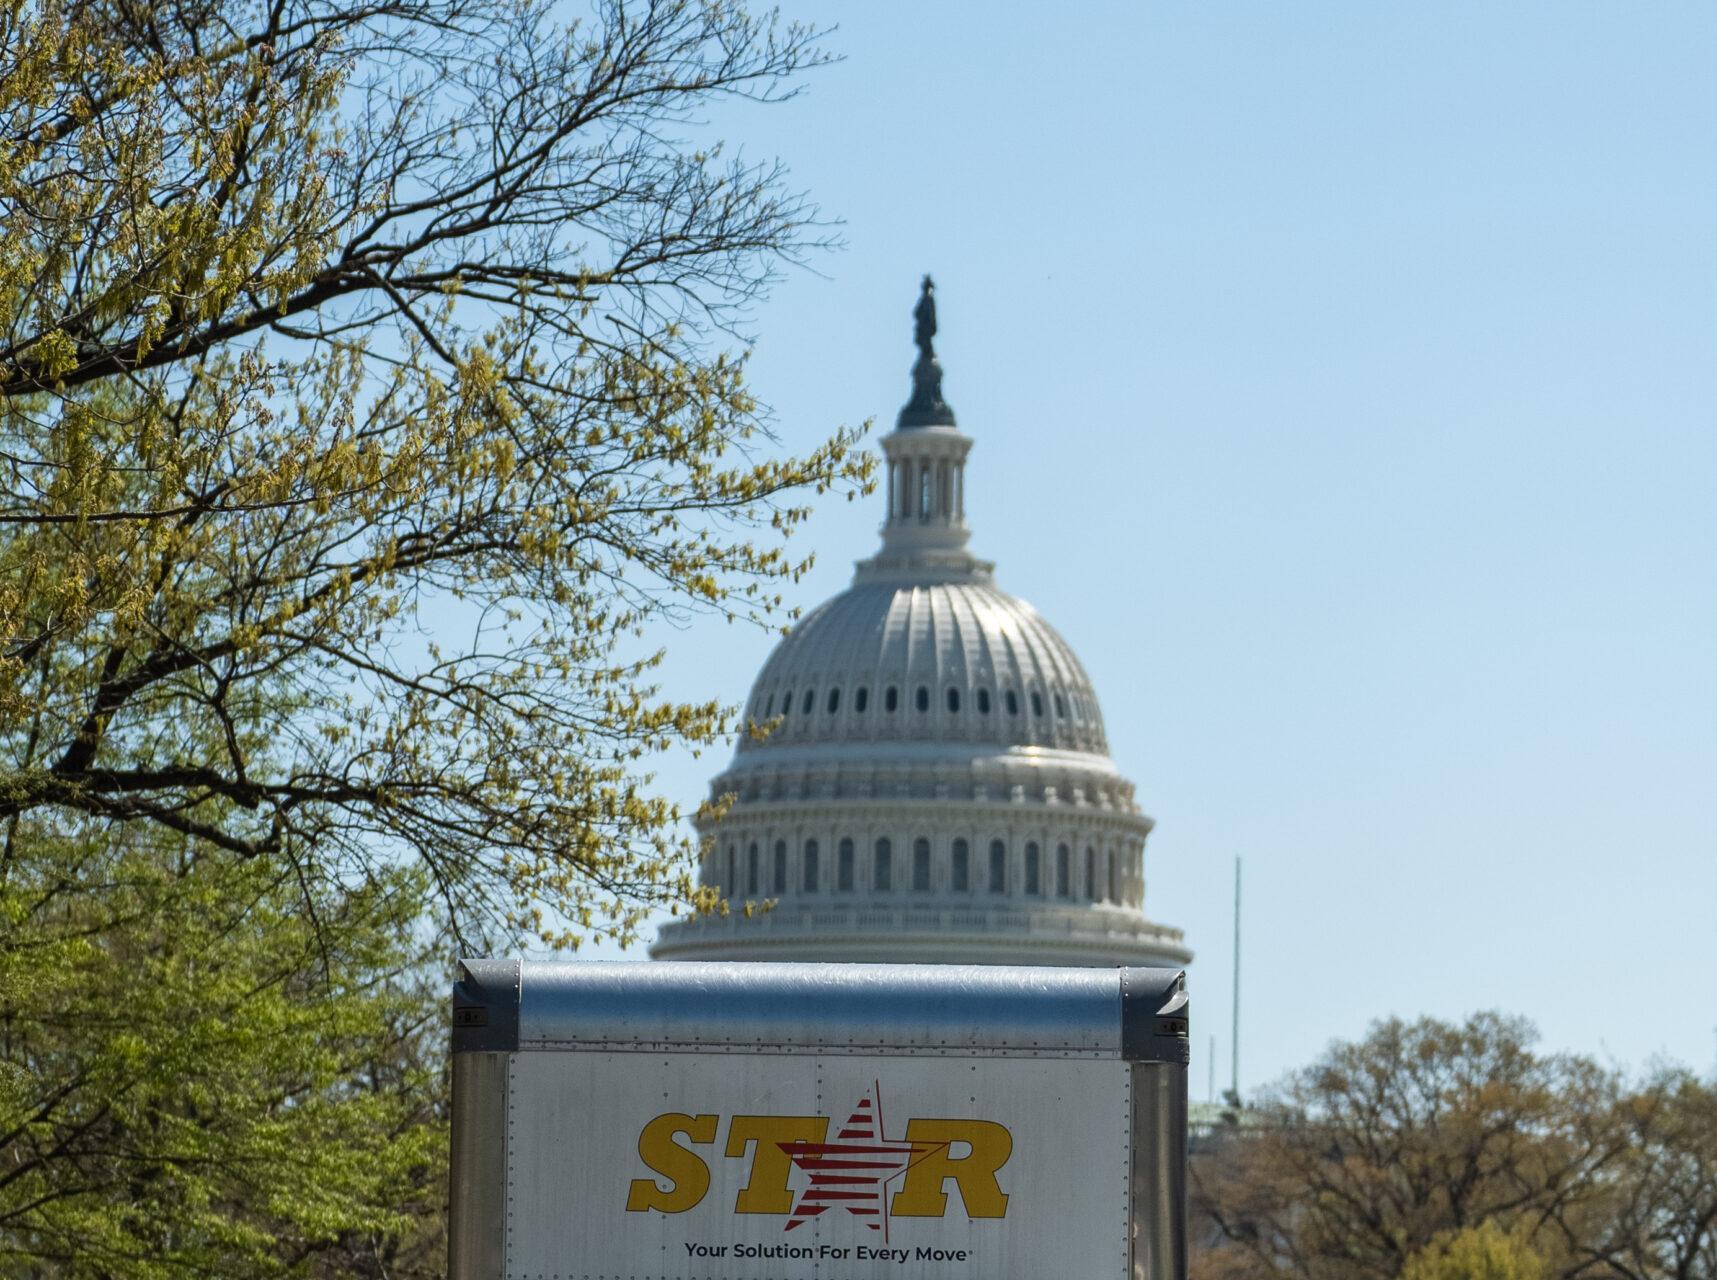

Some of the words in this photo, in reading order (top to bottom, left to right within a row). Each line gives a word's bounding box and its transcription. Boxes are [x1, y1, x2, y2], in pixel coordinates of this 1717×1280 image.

[685, 1243, 728, 1257] Your
[733, 1243, 813, 1259] Solution
[820, 1245, 850, 1259] For
[857, 1246, 909, 1264] Every
[916, 1247, 967, 1261] Move
